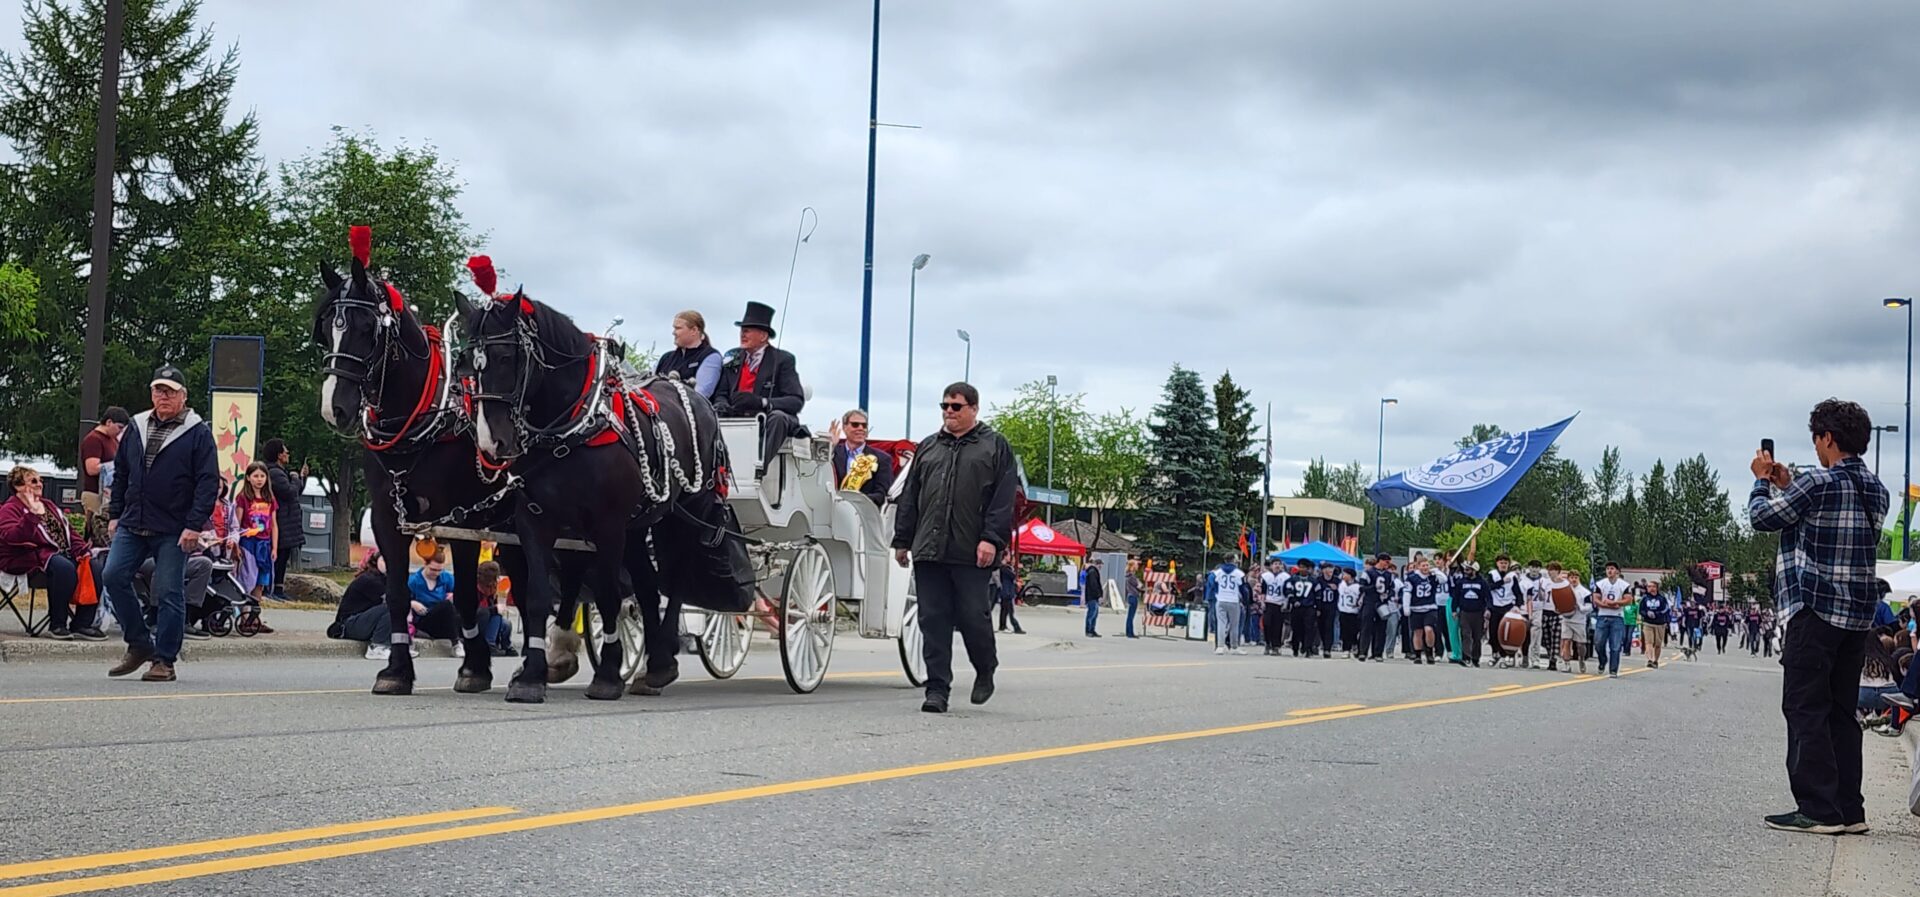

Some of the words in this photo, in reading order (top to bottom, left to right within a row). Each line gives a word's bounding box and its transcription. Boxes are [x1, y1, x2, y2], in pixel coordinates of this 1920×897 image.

[1221, 575, 1236, 590] 35
[1295, 581, 1312, 598] 97
[1267, 585, 1281, 596] 84
[1322, 590, 1334, 602] 10
[1416, 584, 1432, 598] 62
